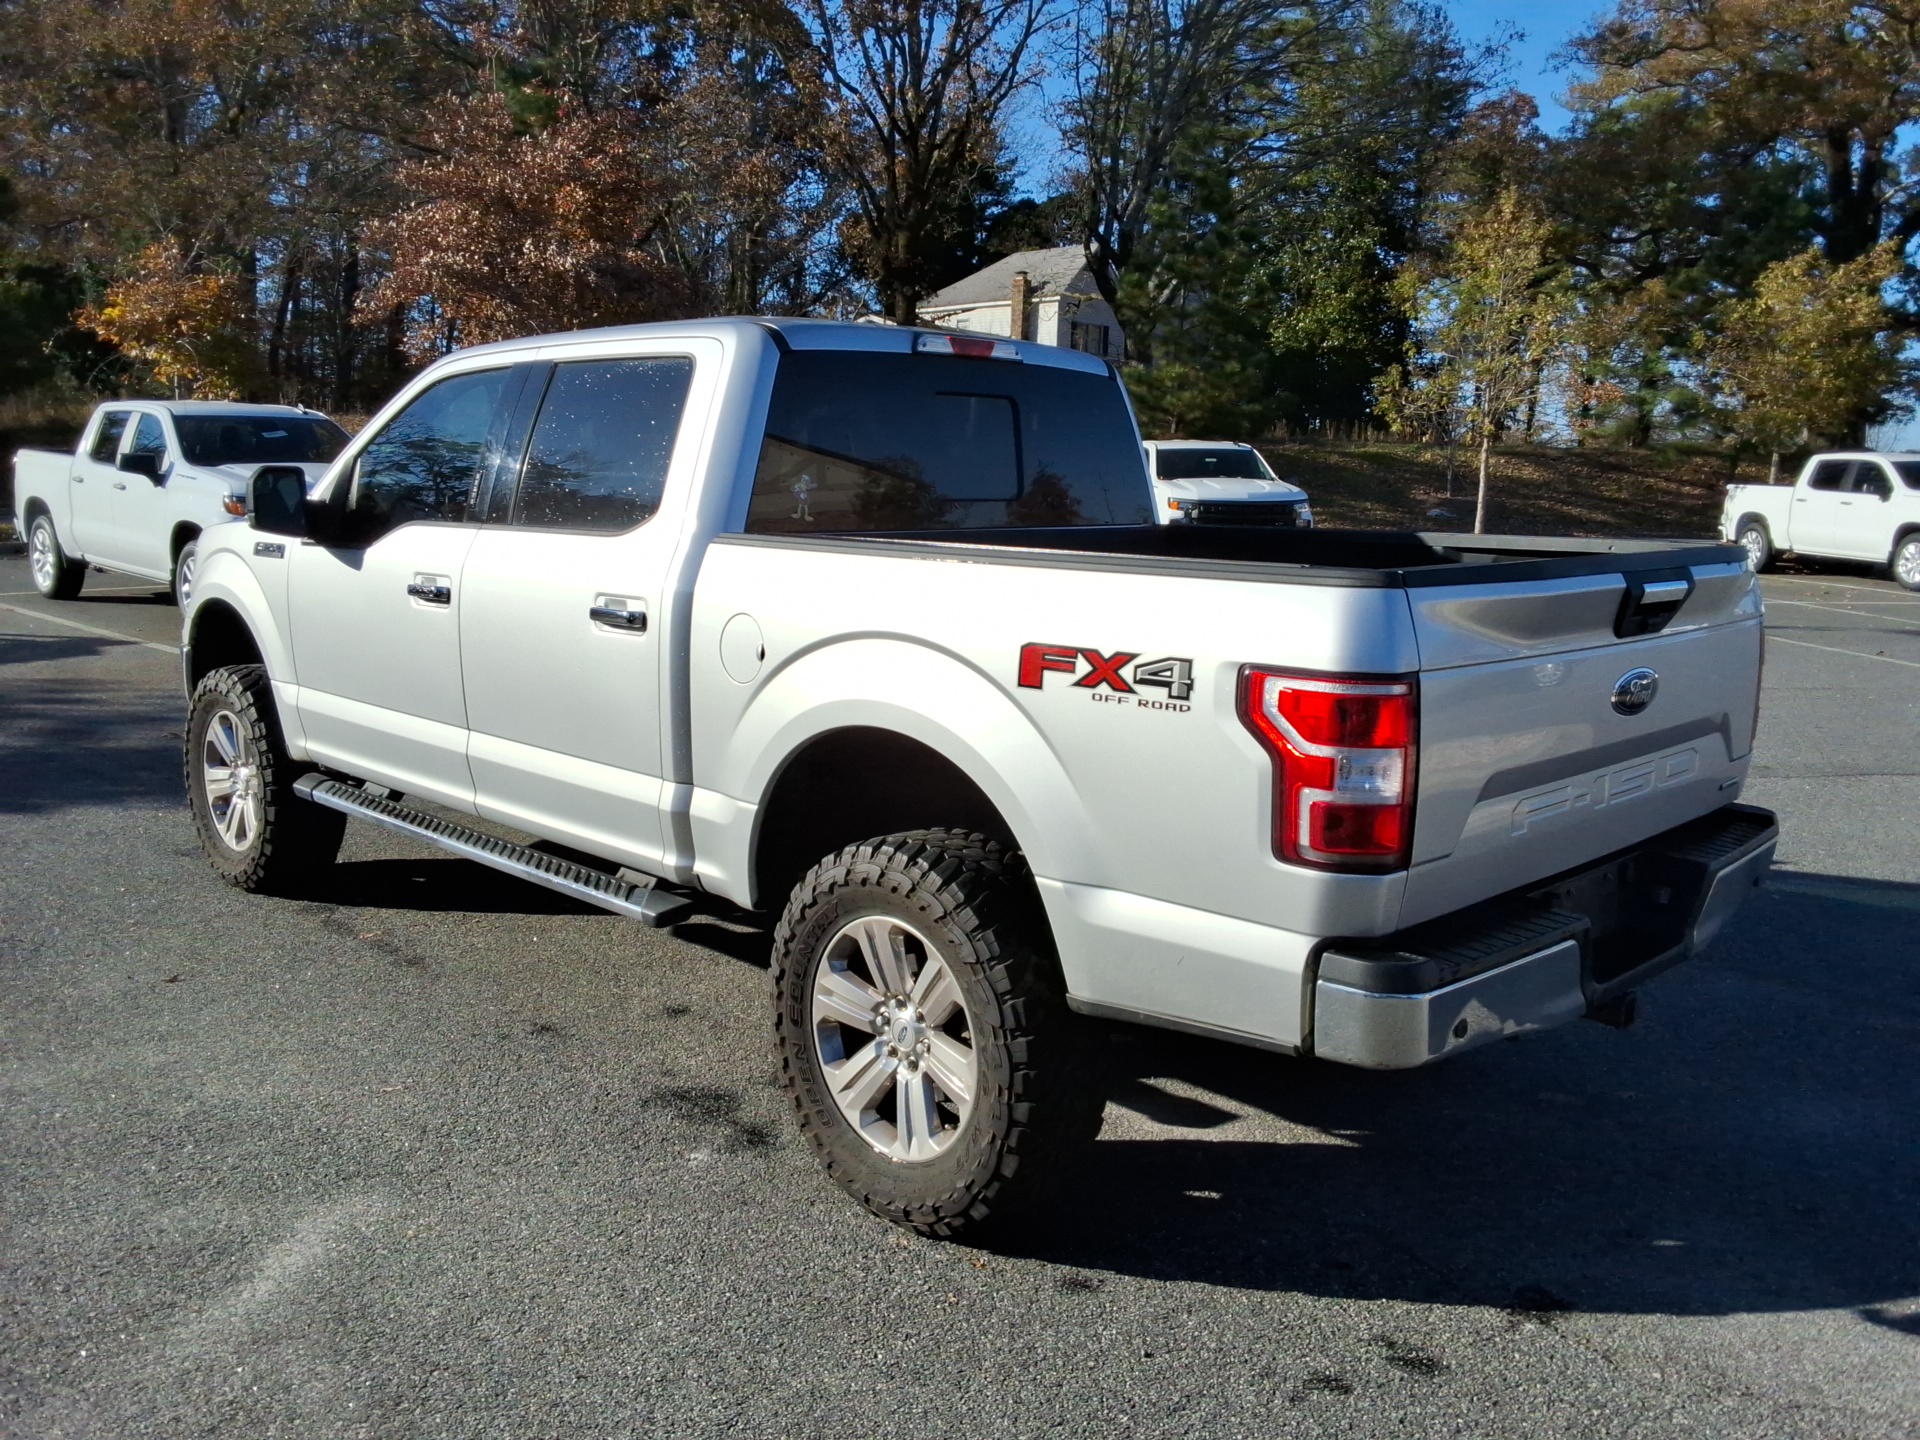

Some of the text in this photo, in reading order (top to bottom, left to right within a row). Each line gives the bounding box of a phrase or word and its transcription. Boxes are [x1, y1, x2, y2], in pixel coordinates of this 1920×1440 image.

[1017, 641, 1194, 701] FX4
[1626, 679, 1653, 704] Ford
[1092, 692, 1192, 713] OFF ROAD
[1510, 746, 1700, 838] F-150
[787, 901, 840, 1128] OPEN COUNTRY
